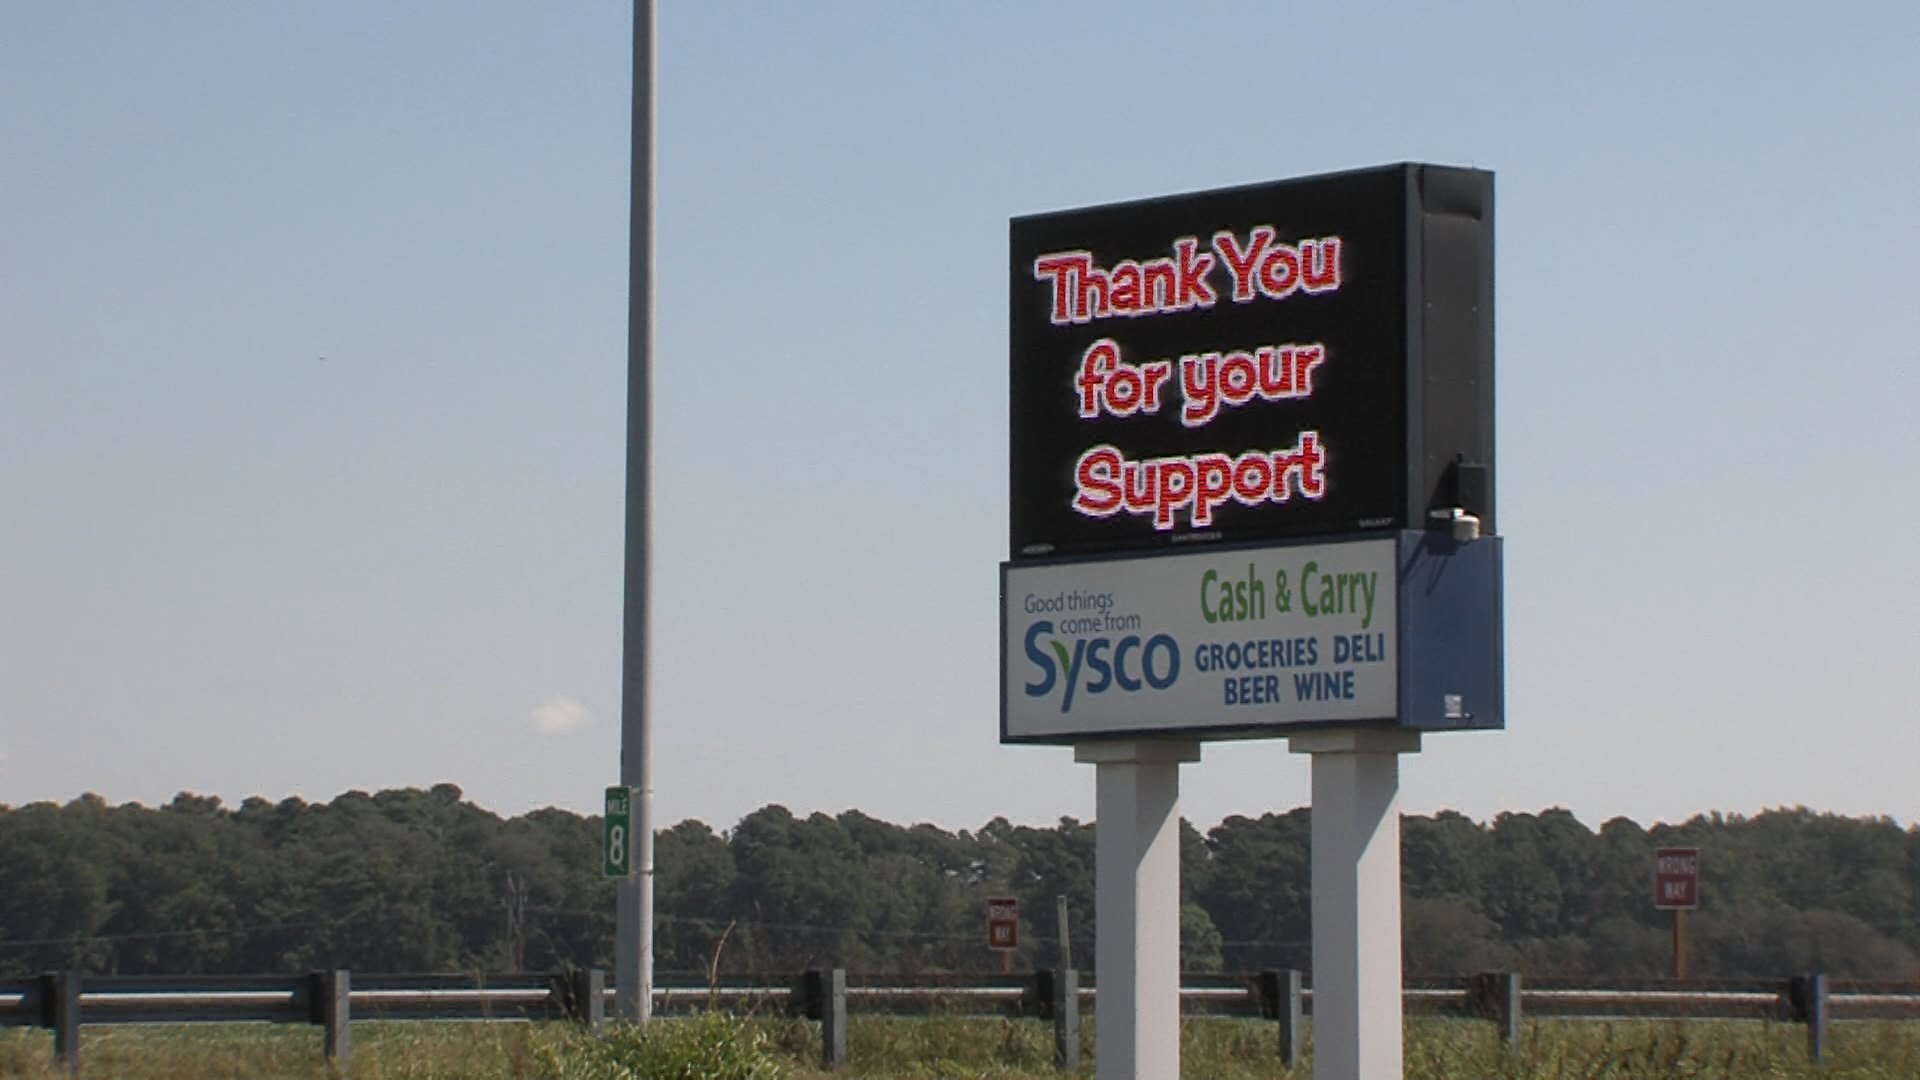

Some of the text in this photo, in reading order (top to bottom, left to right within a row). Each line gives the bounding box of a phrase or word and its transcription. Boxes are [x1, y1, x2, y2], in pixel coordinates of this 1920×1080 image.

[1034, 225, 1342, 324] Thank You
[1074, 338, 1325, 427] for your
[1072, 431, 1327, 530] Support
[1024, 590, 1113, 614] Good things
[1201, 561, 1377, 630] Cash & Carry
[1060, 610, 1141, 634] come from
[1194, 632, 1385, 672] GROCERIES DELI
[1224, 670, 1355, 706] BEER WINE
[606, 798, 628, 815] MILE
[610, 825, 624, 865] 8
